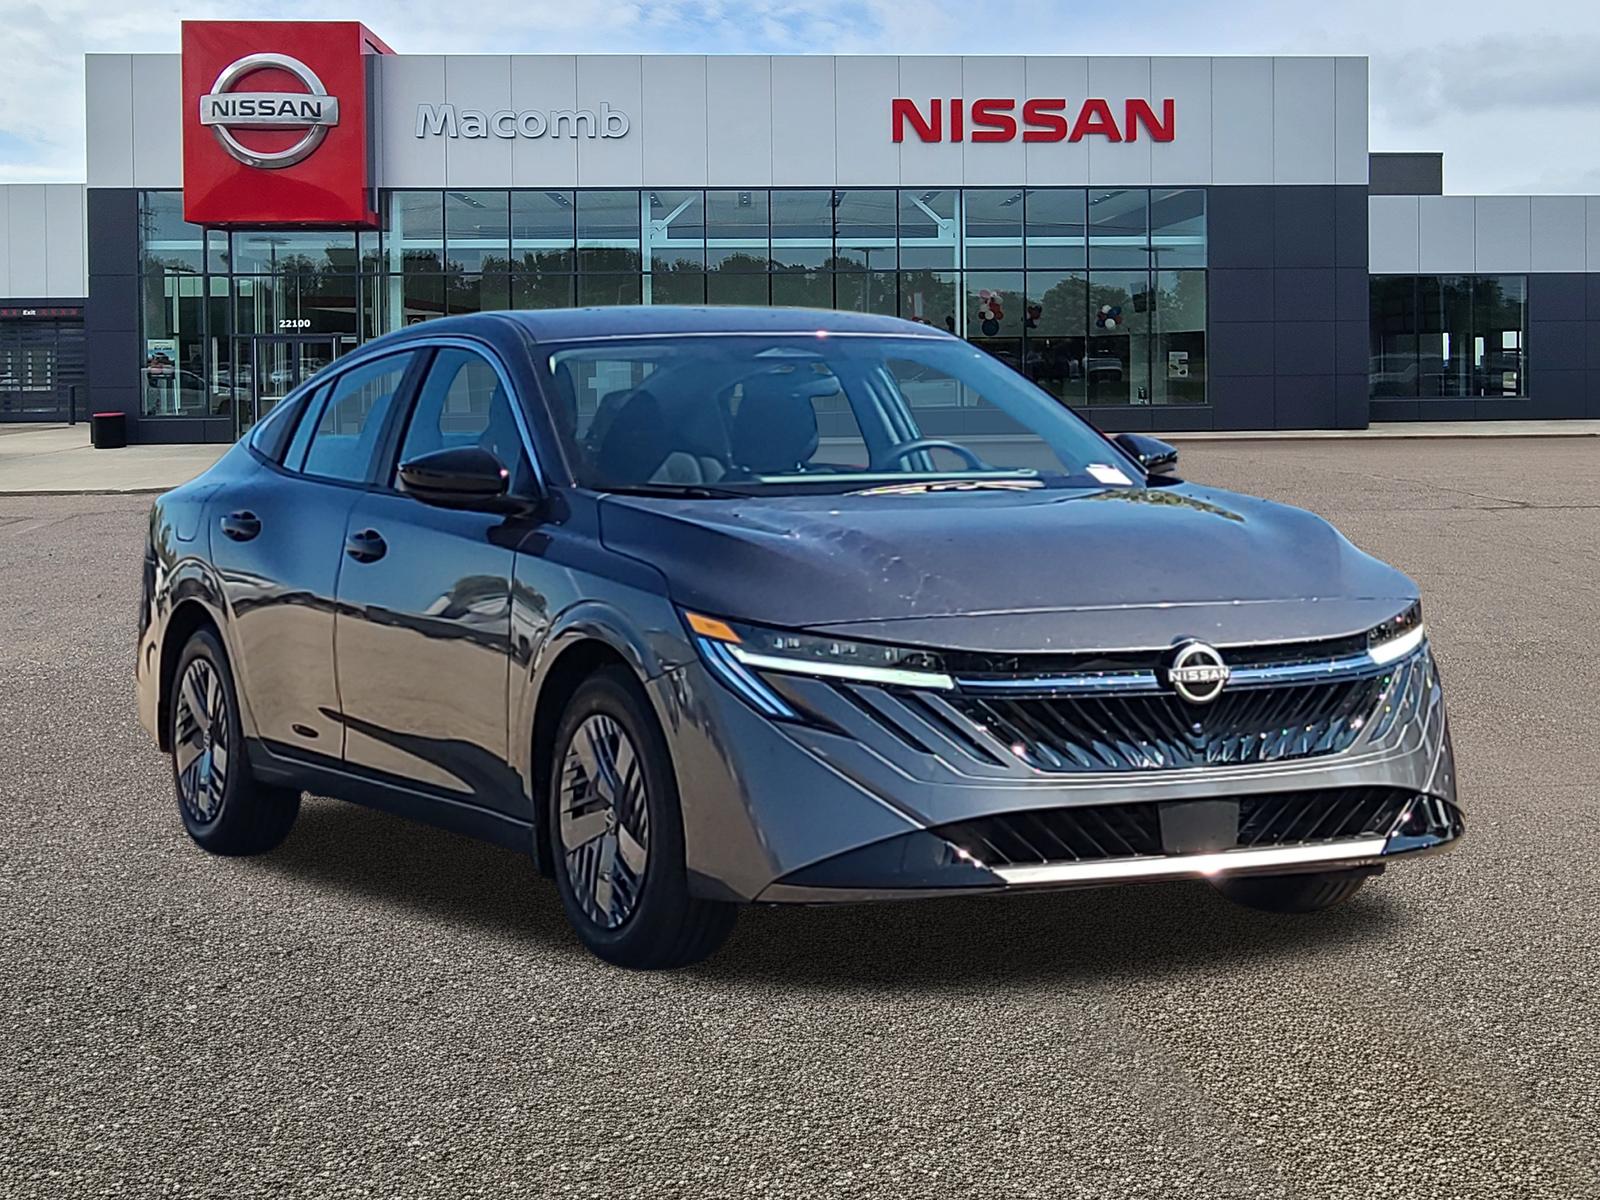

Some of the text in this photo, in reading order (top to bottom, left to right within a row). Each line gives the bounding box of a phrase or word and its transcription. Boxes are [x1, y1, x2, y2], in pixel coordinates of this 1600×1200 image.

[212, 100, 322, 117] NISSAN
[415, 102, 629, 138] Macomb
[891, 98, 1175, 142] NISSAN
[279, 319, 311, 328] 22100
[1168, 667, 1229, 682] NISSAN
